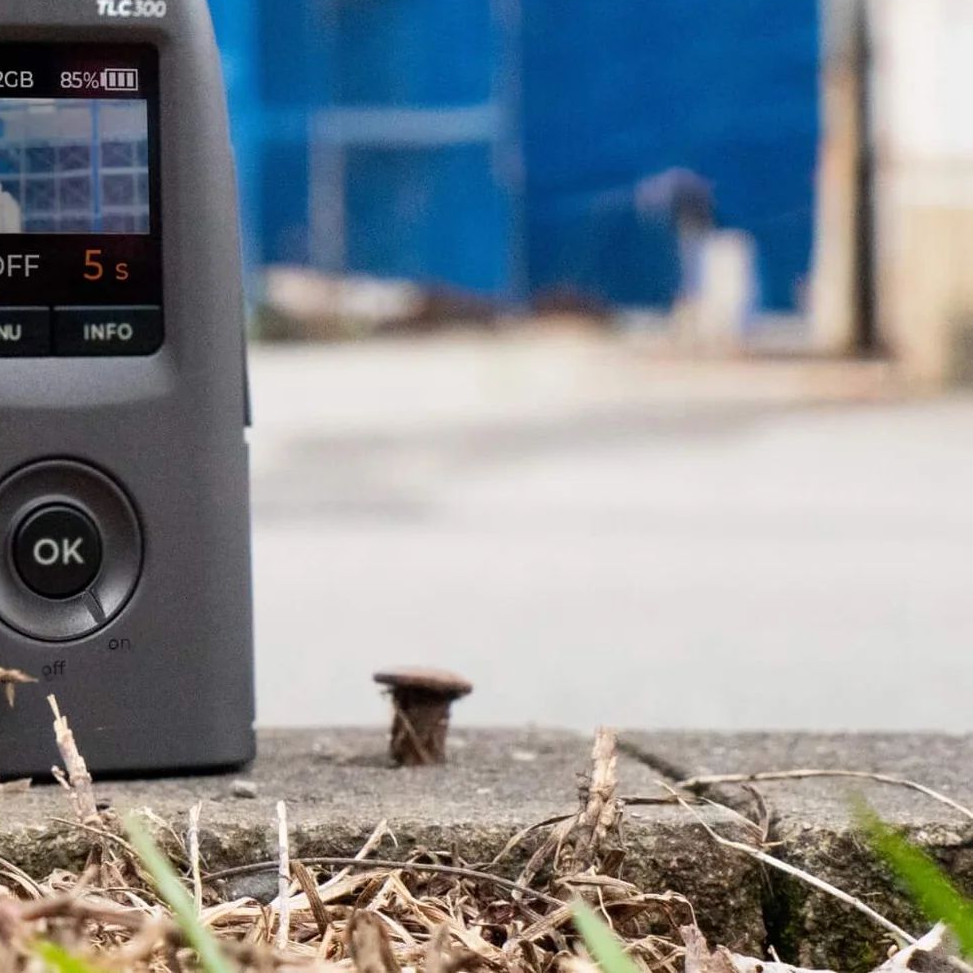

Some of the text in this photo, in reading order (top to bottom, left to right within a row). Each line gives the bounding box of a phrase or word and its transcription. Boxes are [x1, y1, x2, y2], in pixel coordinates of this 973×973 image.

[60, 70, 100, 89] 85%
[83, 249, 104, 281] 5
[83, 323, 133, 341] INFO
[33, 537, 84, 566] OK
[108, 637, 131, 651] on
[42, 660, 67, 677] off
